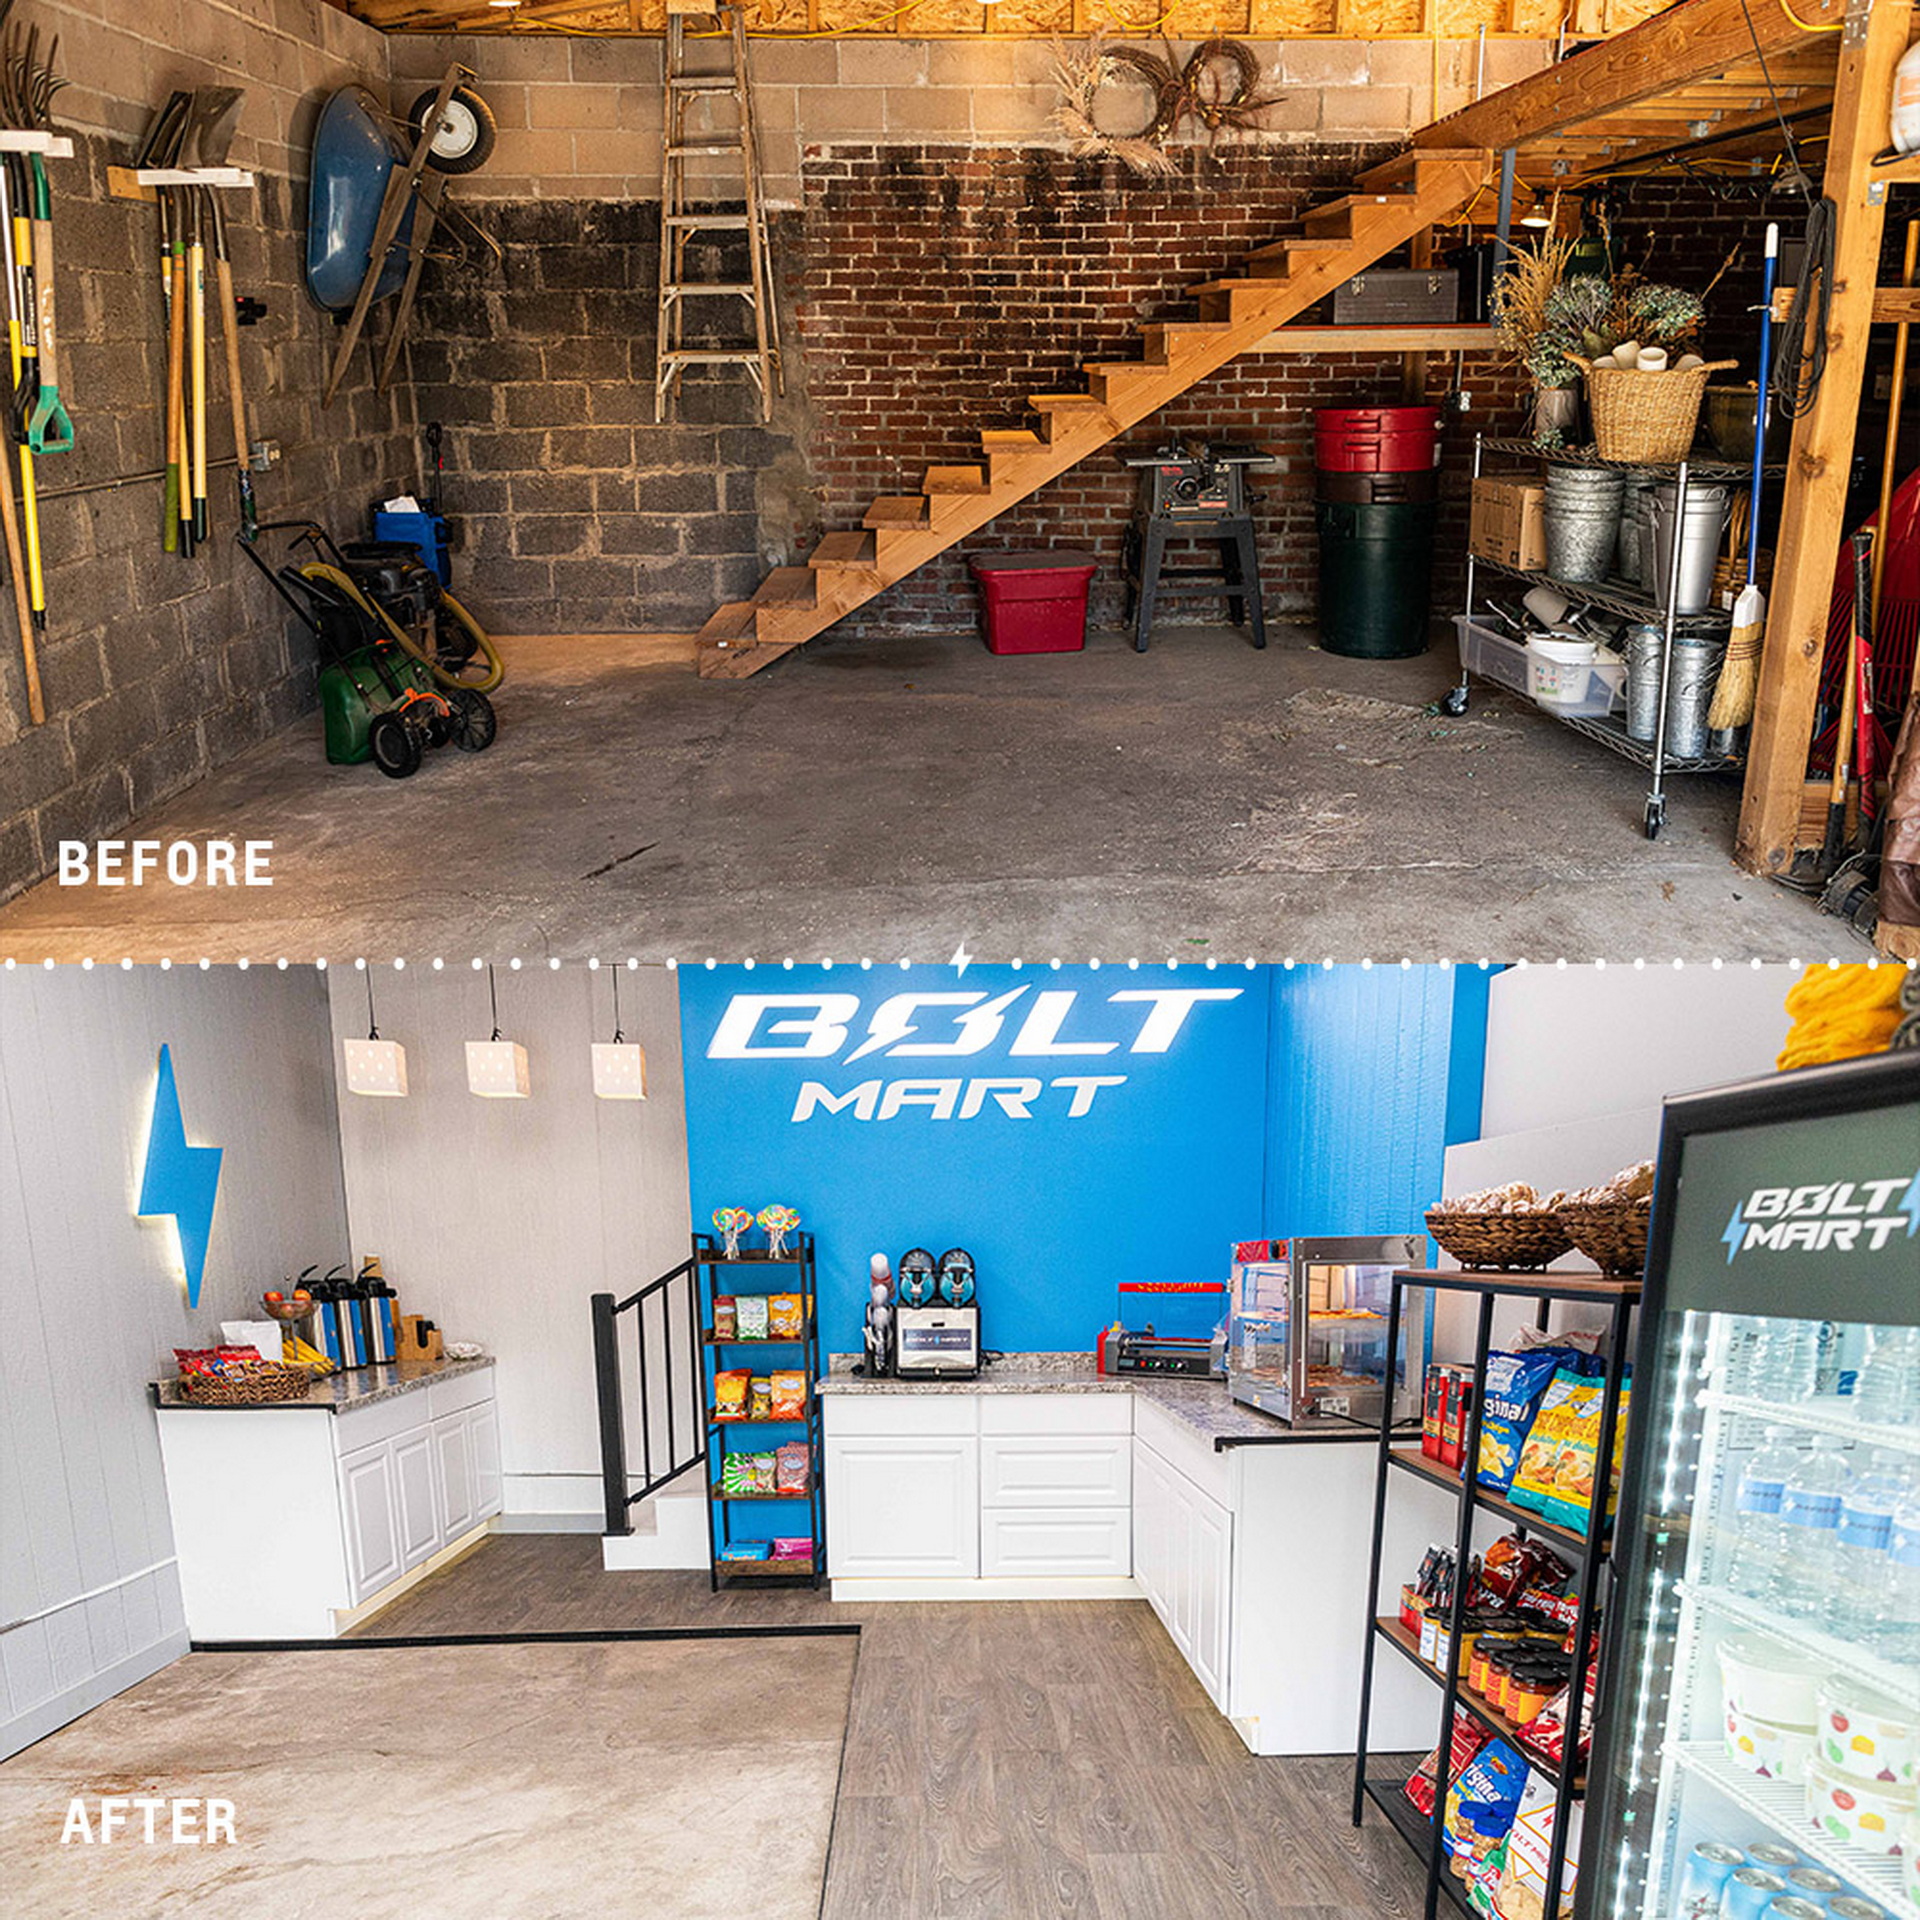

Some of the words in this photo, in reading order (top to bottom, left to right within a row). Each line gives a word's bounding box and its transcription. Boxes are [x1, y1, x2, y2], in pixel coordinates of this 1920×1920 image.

[706, 983, 1244, 1065] BOLT
[791, 1076, 1127, 1122] MART
[1743, 1179, 1913, 1220] BOLT
[1742, 1216, 1909, 1251] MART
[1483, 1394, 1530, 1422] ginal
